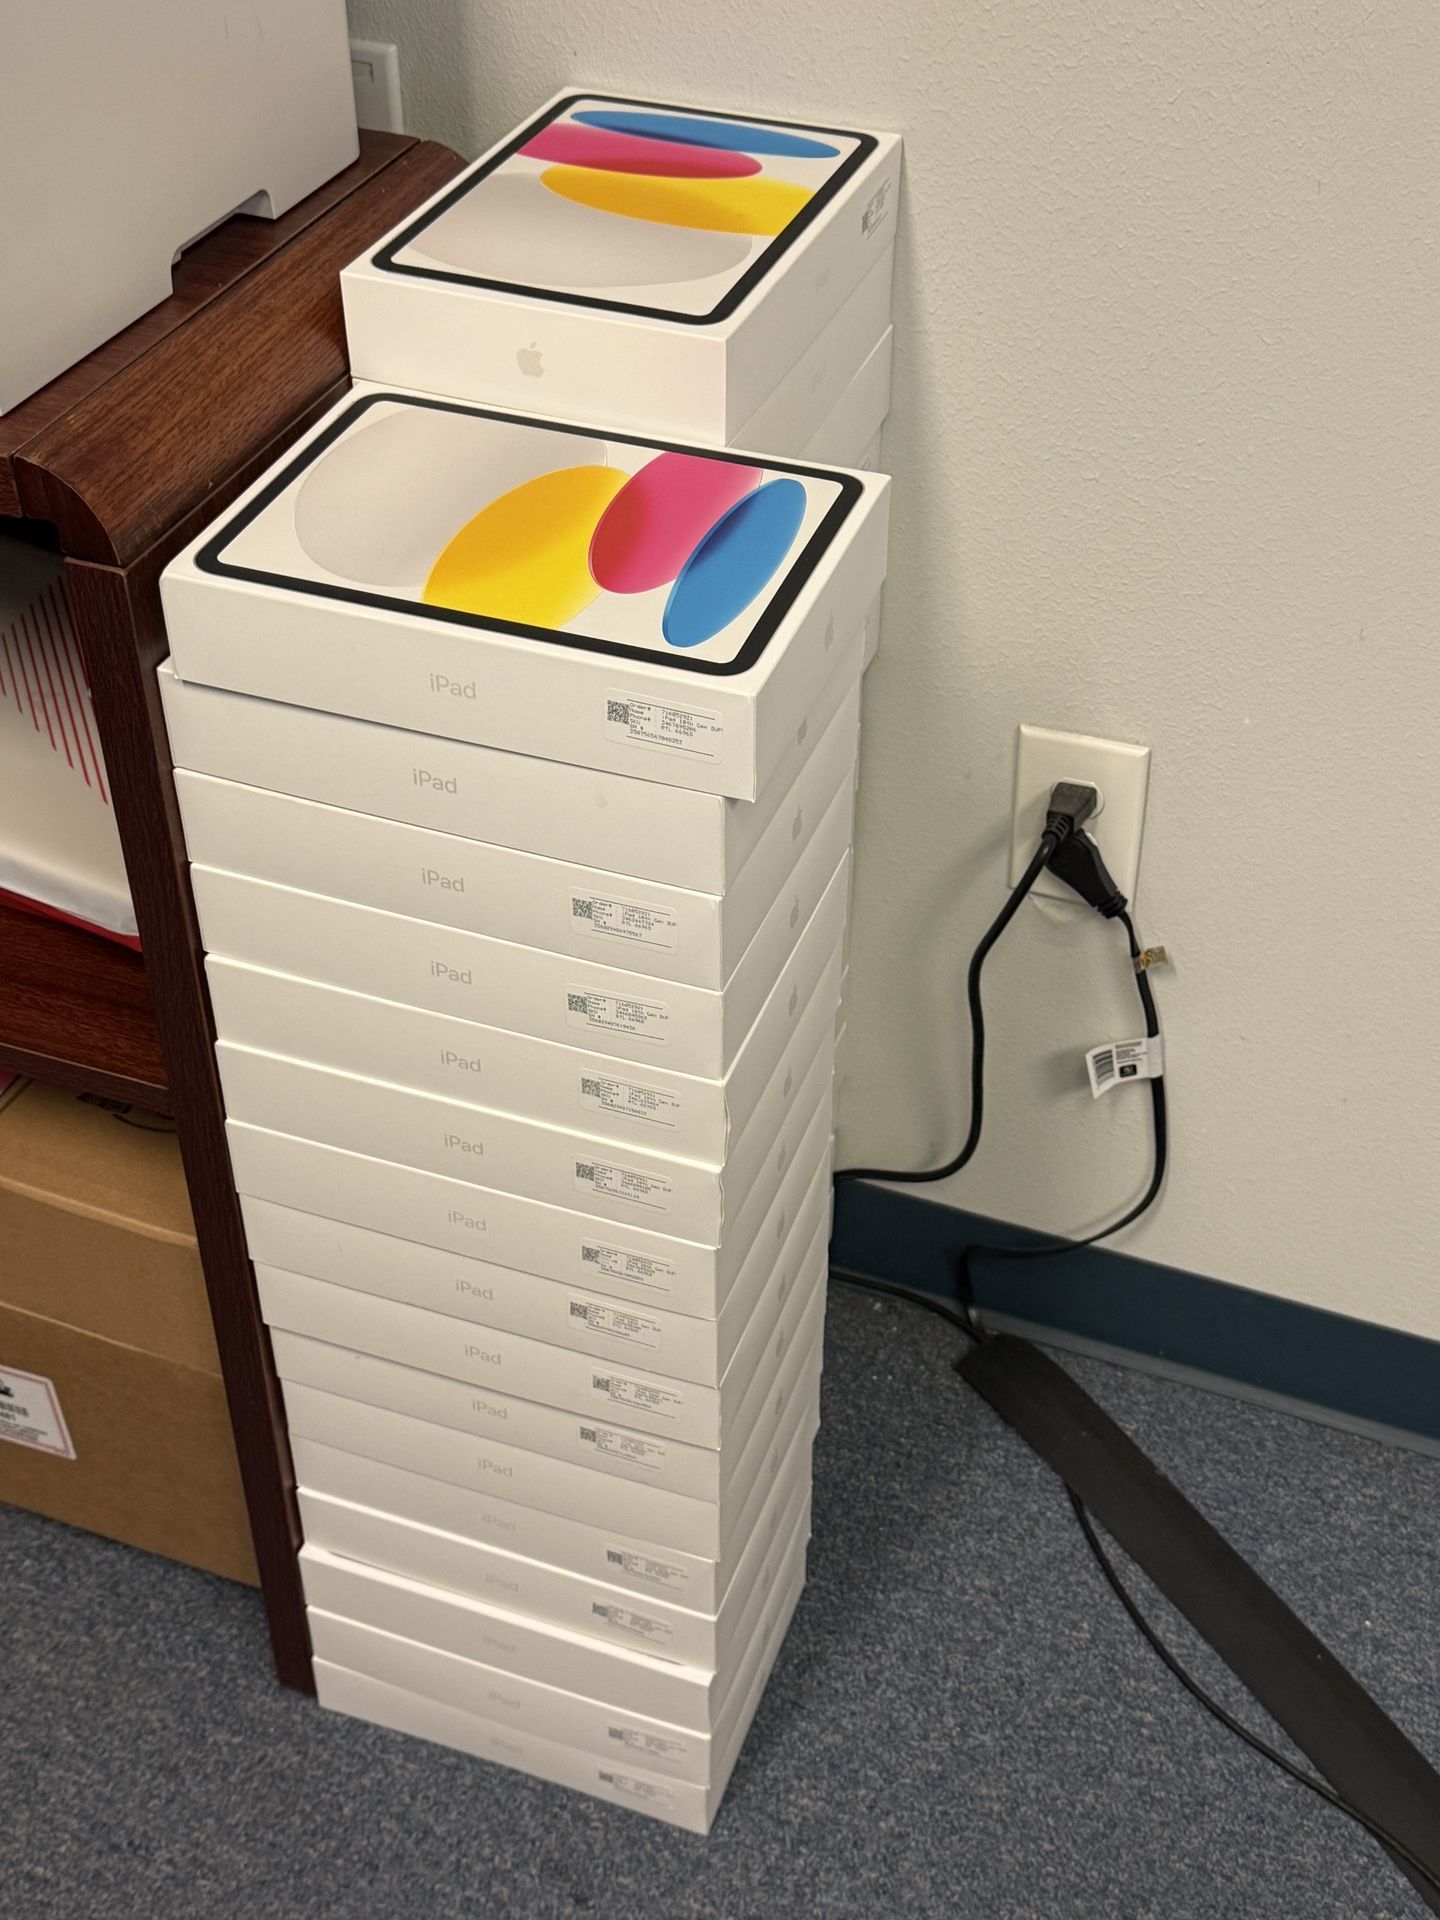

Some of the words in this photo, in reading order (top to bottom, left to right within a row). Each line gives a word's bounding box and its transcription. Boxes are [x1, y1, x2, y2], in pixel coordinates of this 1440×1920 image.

[430, 673, 476, 700] iPad
[413, 768, 457, 794] iPad
[422, 868, 464, 893] iPad
[431, 961, 472, 985] iPad
[441, 1050, 481, 1073] iPad
[444, 1133, 483, 1156] iPad
[448, 1210, 486, 1231] iPad
[456, 1280, 493, 1300] iPad
[465, 1345, 501, 1365] iPad
[472, 1401, 507, 1419] iPad
[478, 1459, 512, 1477] iPad
[481, 1514, 516, 1532] iPad
[488, 1691, 520, 1709] iPad
